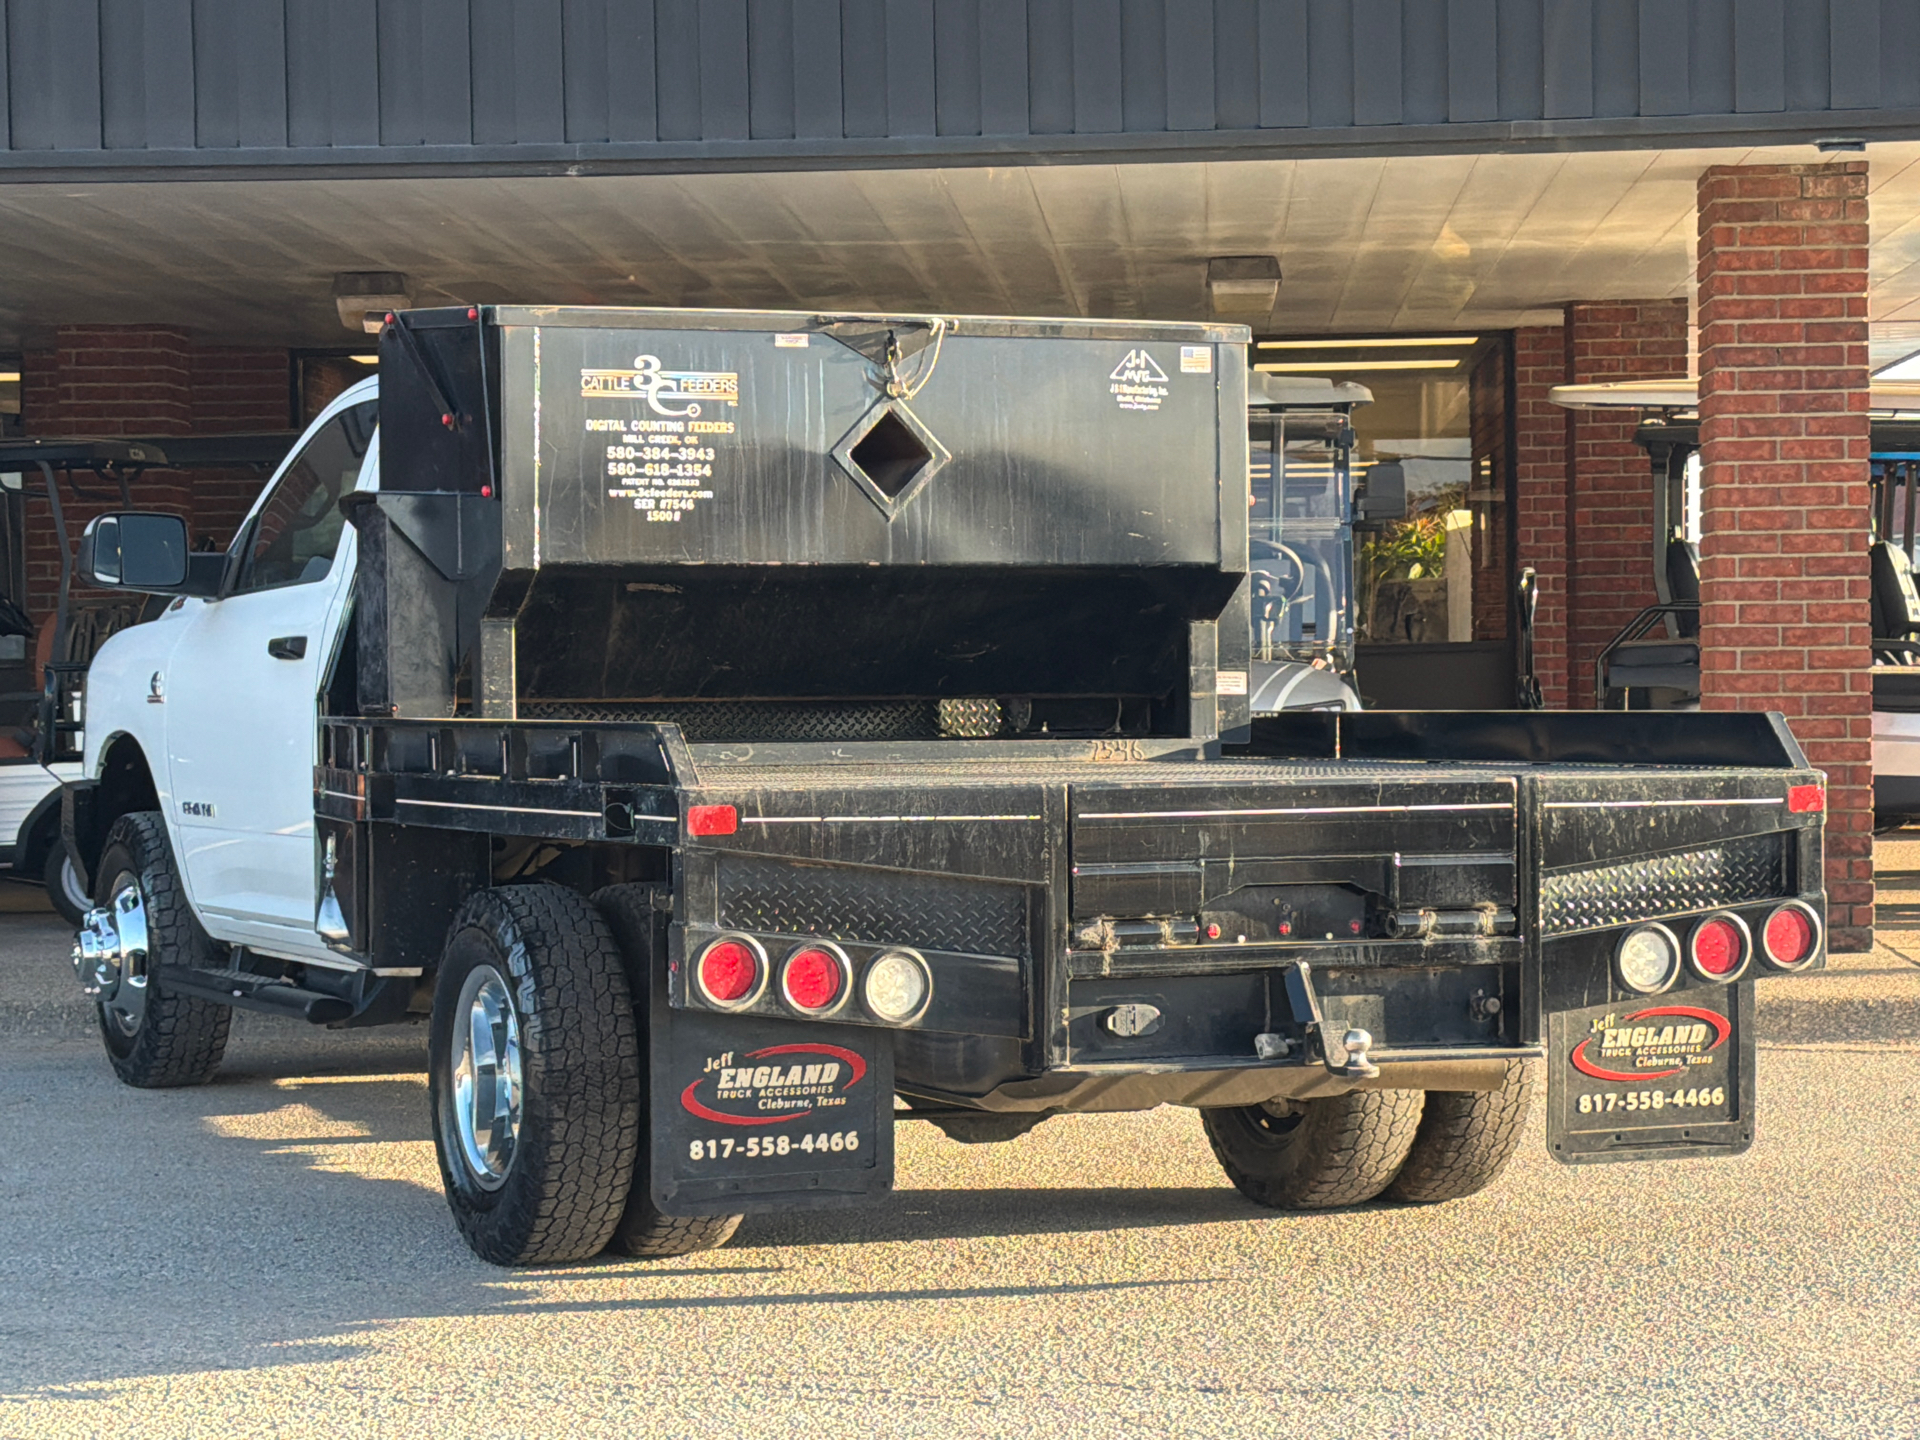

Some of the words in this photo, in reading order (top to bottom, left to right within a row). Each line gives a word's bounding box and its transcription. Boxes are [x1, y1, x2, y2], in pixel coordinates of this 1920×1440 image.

[581, 376, 630, 391] CATTLE
[680, 378, 738, 393] FEEDERS
[585, 419, 627, 431] DIGITAL
[631, 420, 684, 432] COUNTING
[688, 421, 735, 434] FEEDERS
[622, 434, 645, 444] MILL
[648, 434, 682, 446] CREEK,
[684, 435, 699, 445] OK
[606, 446, 715, 460] 580-384-3943
[607, 462, 712, 477] 580-618-1354
[608, 487, 714, 499] www.3cfeeders.com
[634, 498, 656, 509] SER
[659, 499, 695, 510] #7546
[1590, 1013, 1615, 1033] Jeff
[1602, 1024, 1707, 1048] ENGLAND
[1601, 1048, 1631, 1057] TRUCK
[1636, 1045, 1701, 1055] ACCESSORIES
[703, 1051, 734, 1073] Jeff
[1636, 1056, 1683, 1067] Cleburne,
[1686, 1054, 1713, 1065] Texas
[717, 1062, 840, 1089] ENGLAND
[717, 1089, 752, 1099] TRUCK
[758, 1085, 833, 1097] ACCESSORIES
[758, 1097, 813, 1110] Cleburne,
[816, 1095, 847, 1107] Texas
[1579, 1087, 1725, 1113] 817-558-4466
[689, 1131, 859, 1160] 817-558-4466
